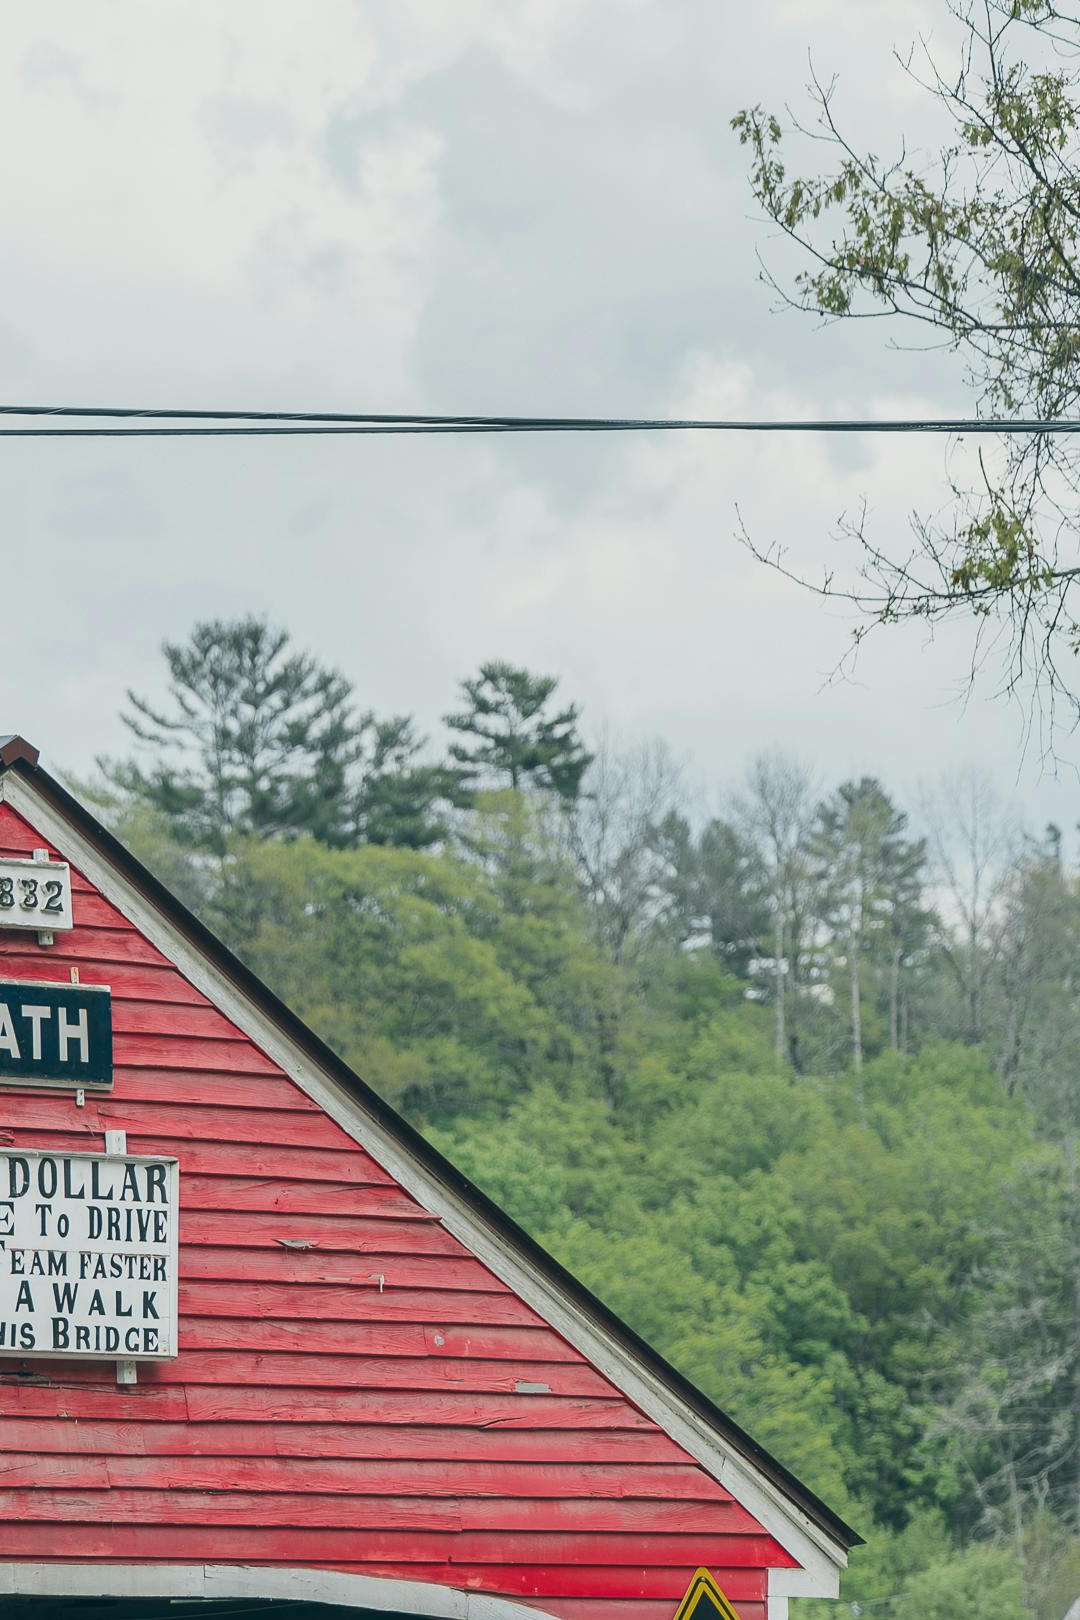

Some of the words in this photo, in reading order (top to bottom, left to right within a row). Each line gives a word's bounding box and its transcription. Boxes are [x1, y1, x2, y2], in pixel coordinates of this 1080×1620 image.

[8, 1157, 169, 1204] DOLLAR
[86, 1205, 168, 1243] DRIVE
[78, 1250, 167, 1281] FASTER
[15, 1280, 35, 1313] A
[52, 1282, 160, 1319] WALK
[50, 1317, 159, 1352] BRIDGE
